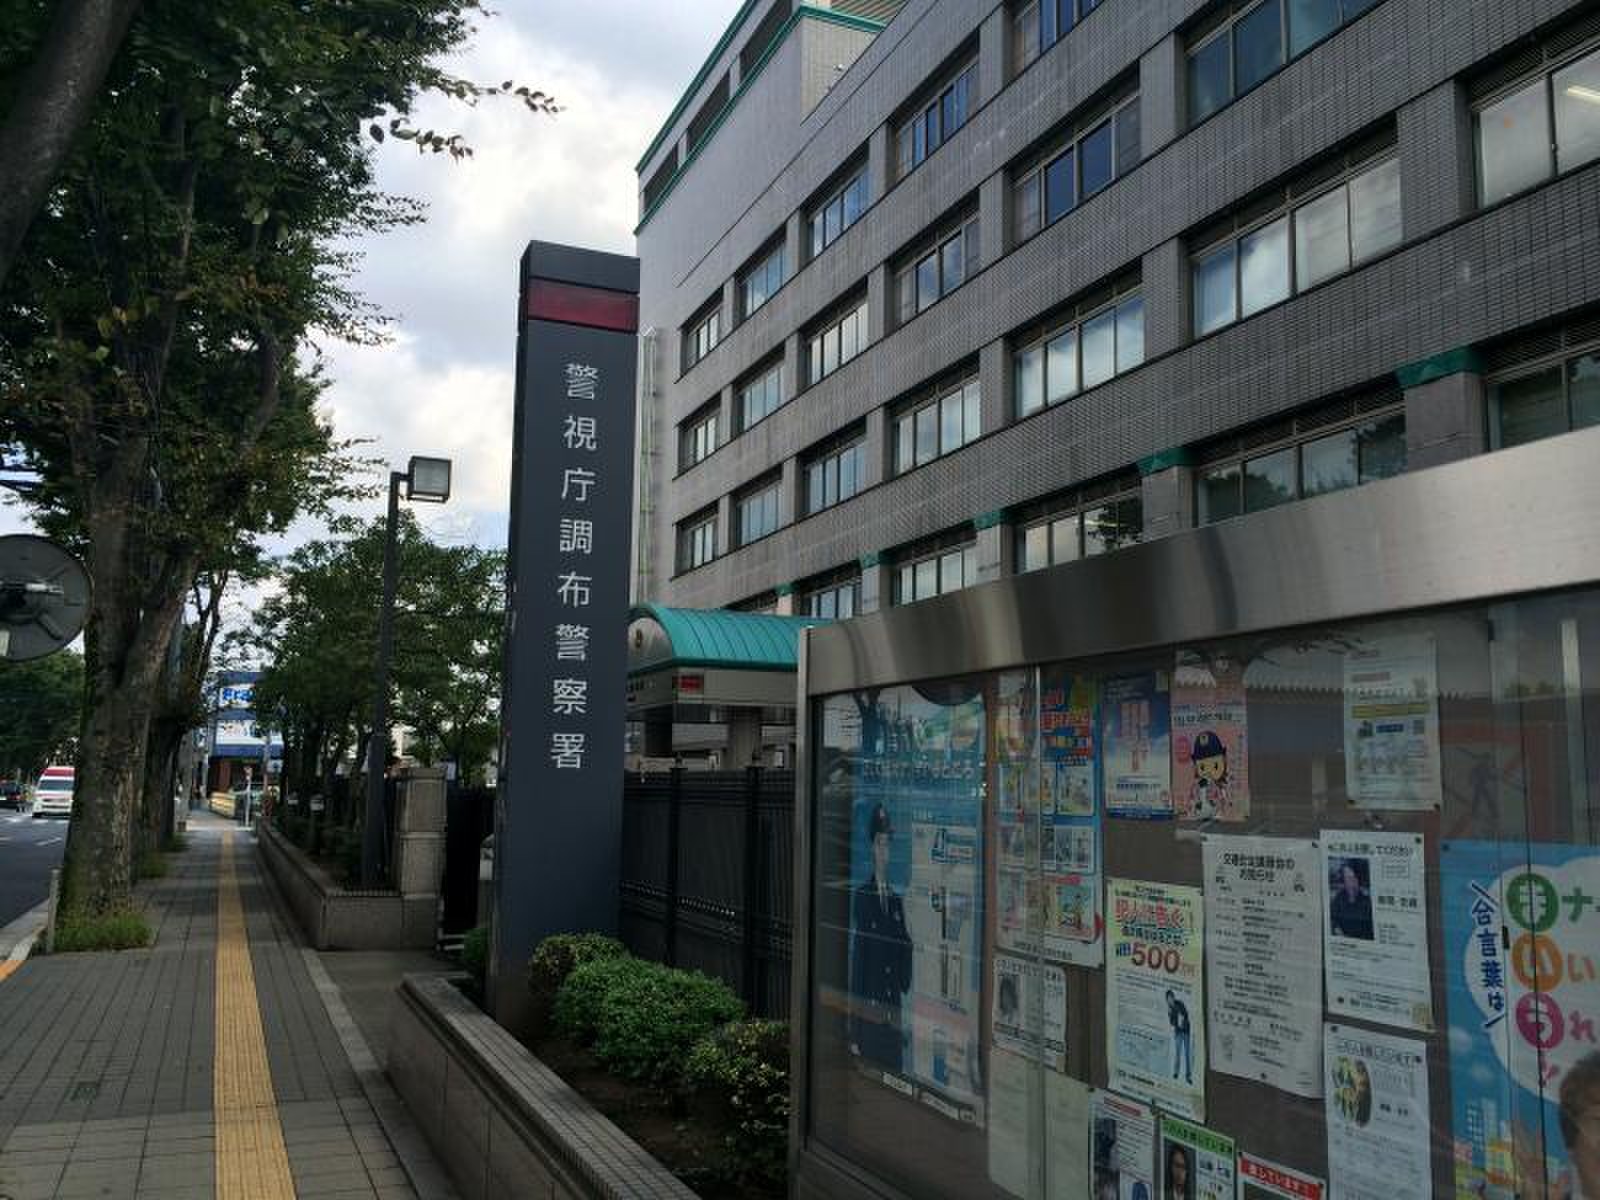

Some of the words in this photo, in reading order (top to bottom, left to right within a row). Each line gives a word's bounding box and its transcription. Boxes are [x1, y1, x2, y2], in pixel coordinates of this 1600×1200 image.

[549, 363, 599, 770] 警視庁調布警察署
[1471, 897, 1506, 1012] 合言葉は
